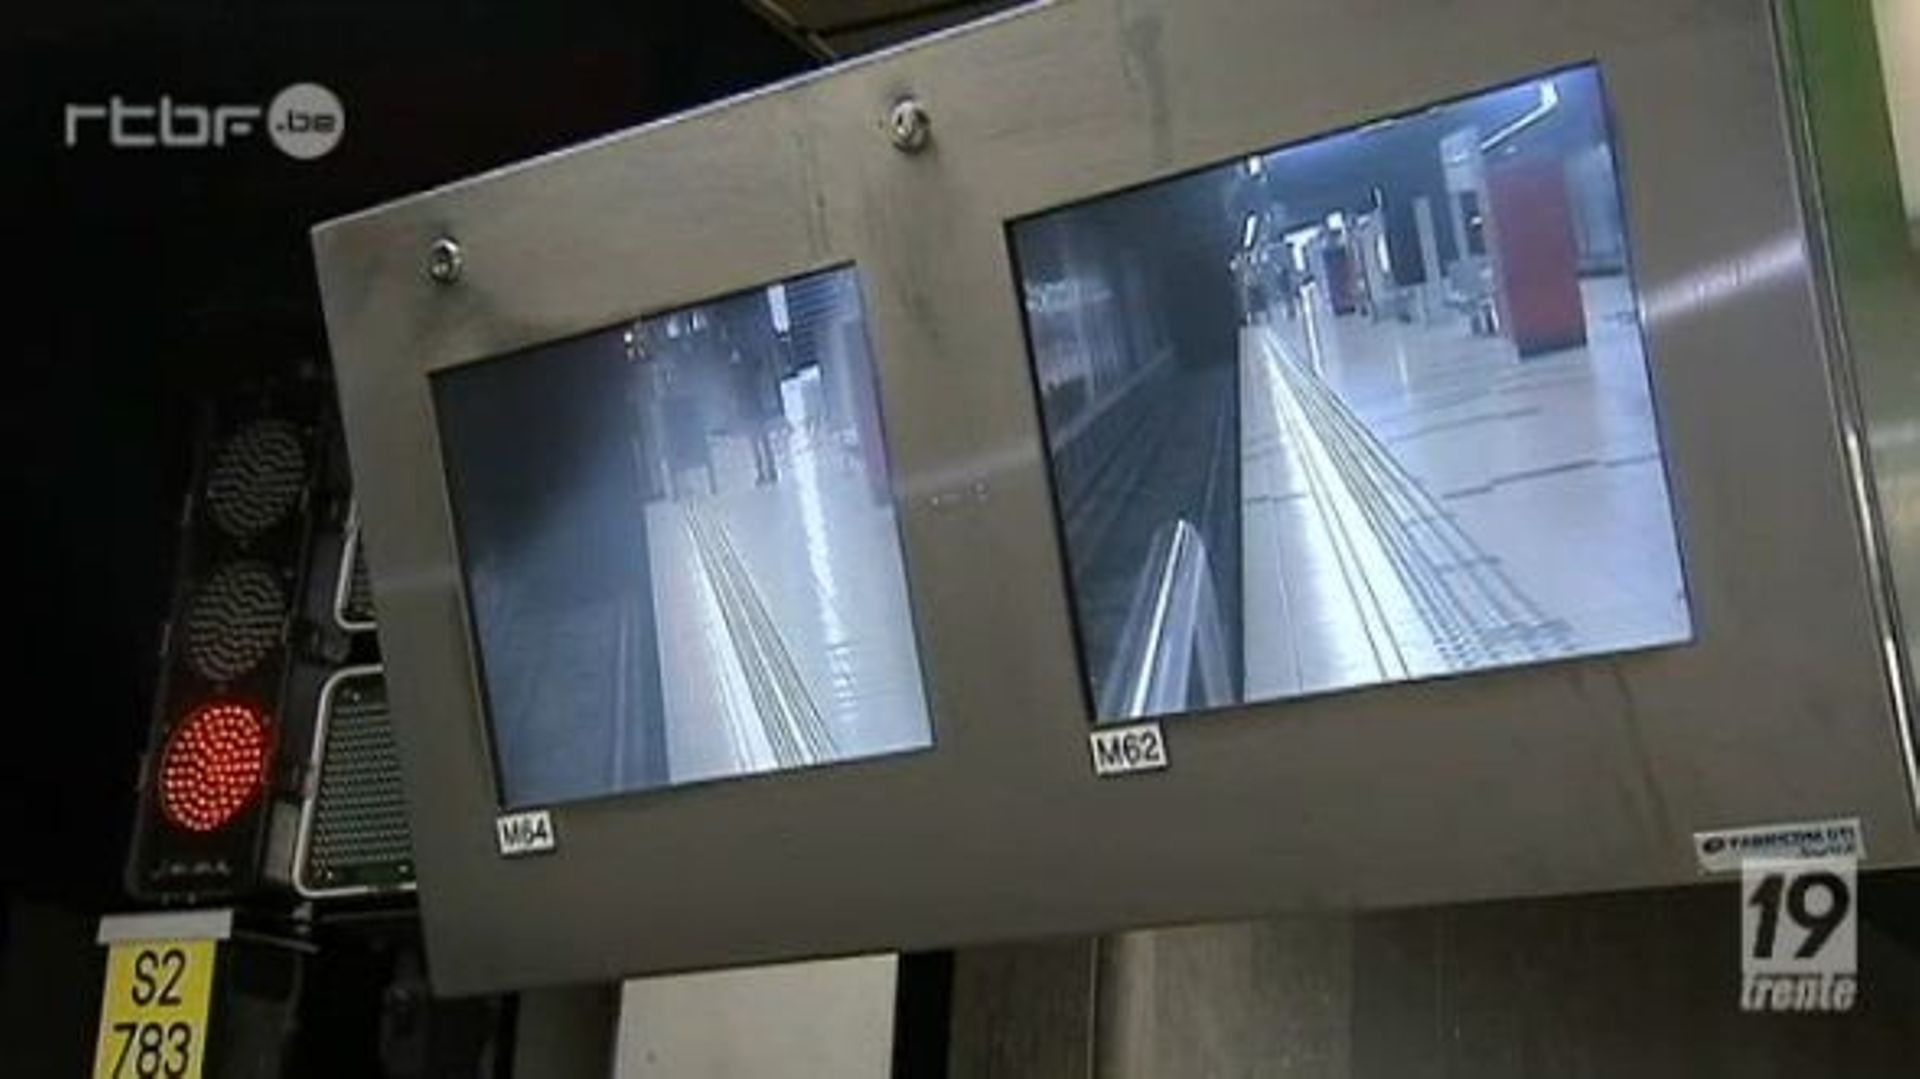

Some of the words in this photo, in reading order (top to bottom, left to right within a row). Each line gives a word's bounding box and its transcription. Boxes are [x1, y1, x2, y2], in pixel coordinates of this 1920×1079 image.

[1097, 731, 1161, 768] M62
[502, 816, 548, 846] M64
[131, 948, 187, 1007] S2
[111, 1022, 193, 1079] 783
